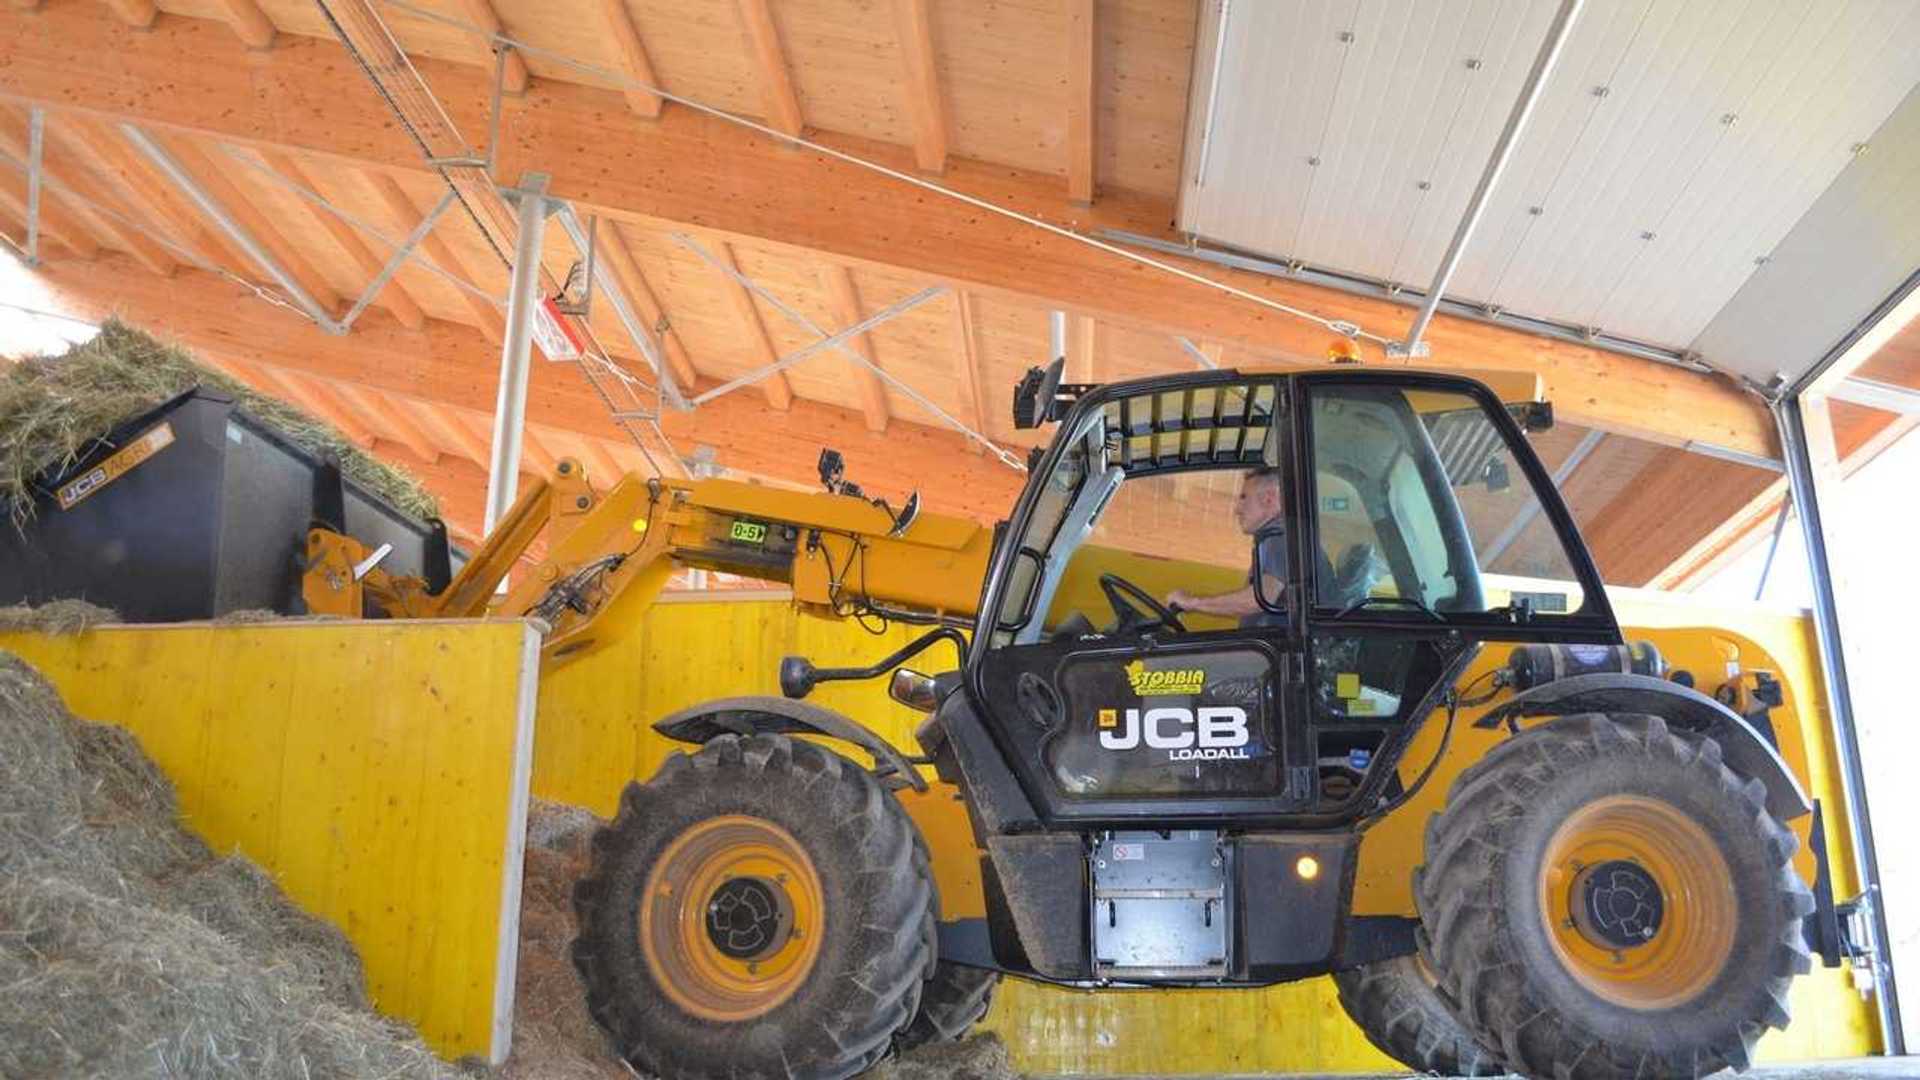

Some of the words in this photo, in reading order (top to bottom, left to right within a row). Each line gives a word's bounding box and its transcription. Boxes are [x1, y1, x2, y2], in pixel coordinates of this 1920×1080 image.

[63, 469, 106, 501] JCB
[1130, 669, 1205, 686] STOBBIA
[1099, 707, 1249, 750] JCB
[1169, 750, 1249, 760] LOADALL
